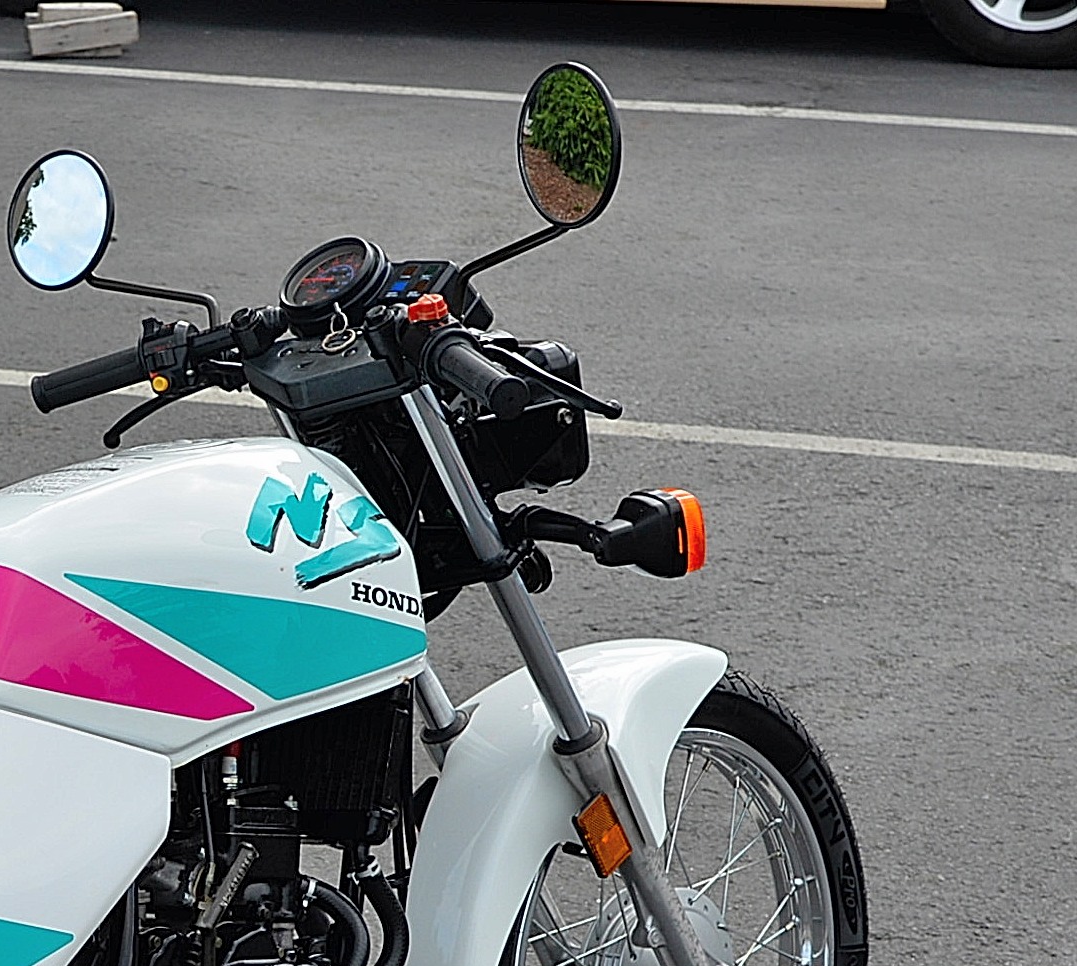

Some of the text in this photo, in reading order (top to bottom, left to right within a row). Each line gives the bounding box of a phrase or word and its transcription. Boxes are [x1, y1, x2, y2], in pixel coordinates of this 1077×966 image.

[351, 582, 424, 618] HOND
[801, 767, 859, 911] CITY Pro
